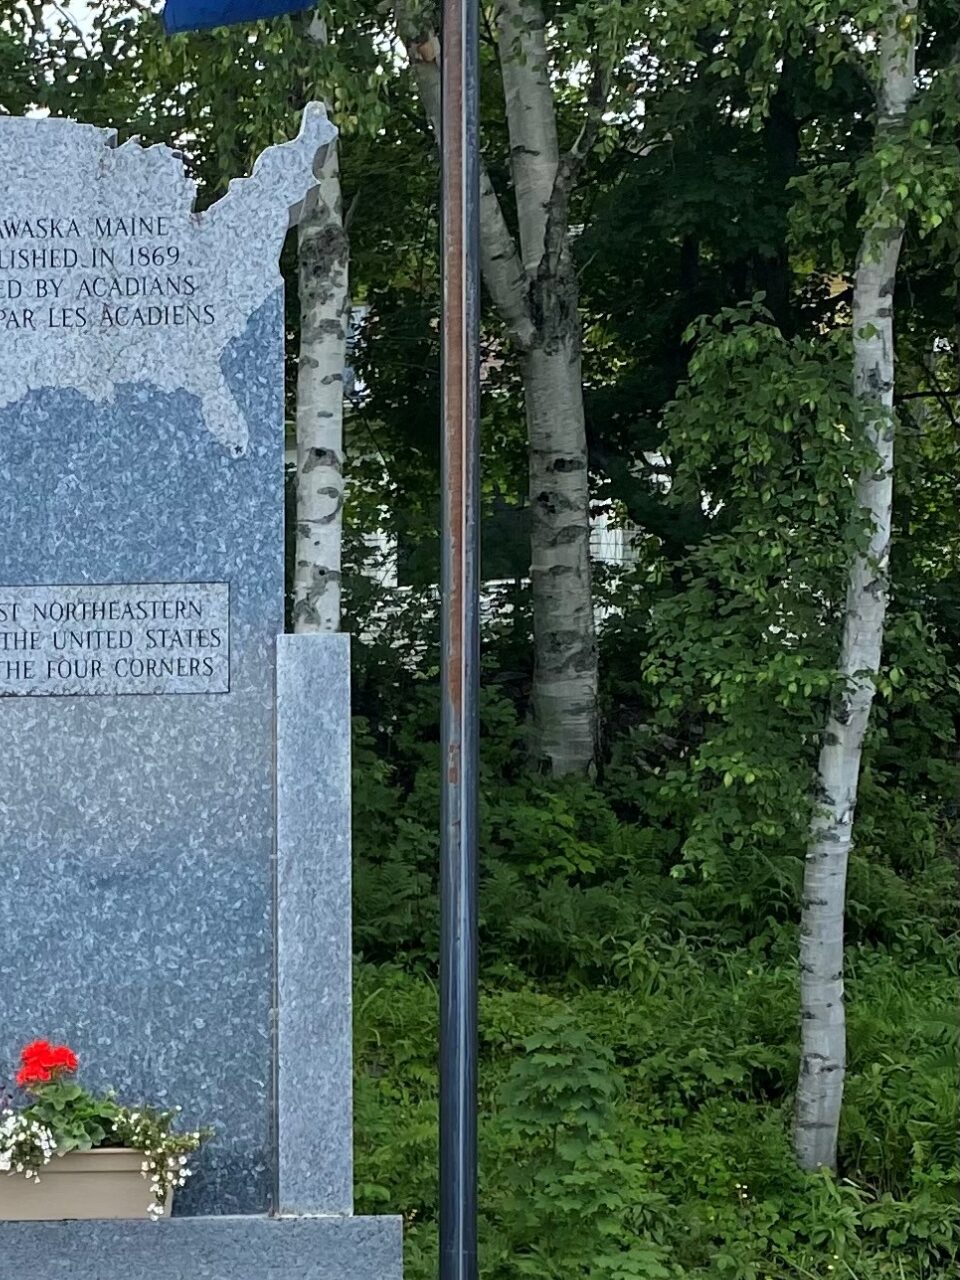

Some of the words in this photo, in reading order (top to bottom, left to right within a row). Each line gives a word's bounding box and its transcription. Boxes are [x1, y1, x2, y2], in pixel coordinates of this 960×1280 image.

[95, 216, 170, 238] MAINE
[91, 248, 116, 268] IN
[129, 246, 180, 267] 1869
[36, 279, 64, 298] BY
[77, 275, 197, 297] ACADIANS
[48, 307, 86, 328] LES
[101, 304, 215, 327] ACADIENS
[33, 600, 203, 622] NORTHEASTERN
[1, 631, 41, 650] THE
[53, 630, 133, 650] UNITED
[146, 628, 221, 648] STATES
[47, 659, 102, 679] FOUR
[115, 657, 214, 677] CORNERS
